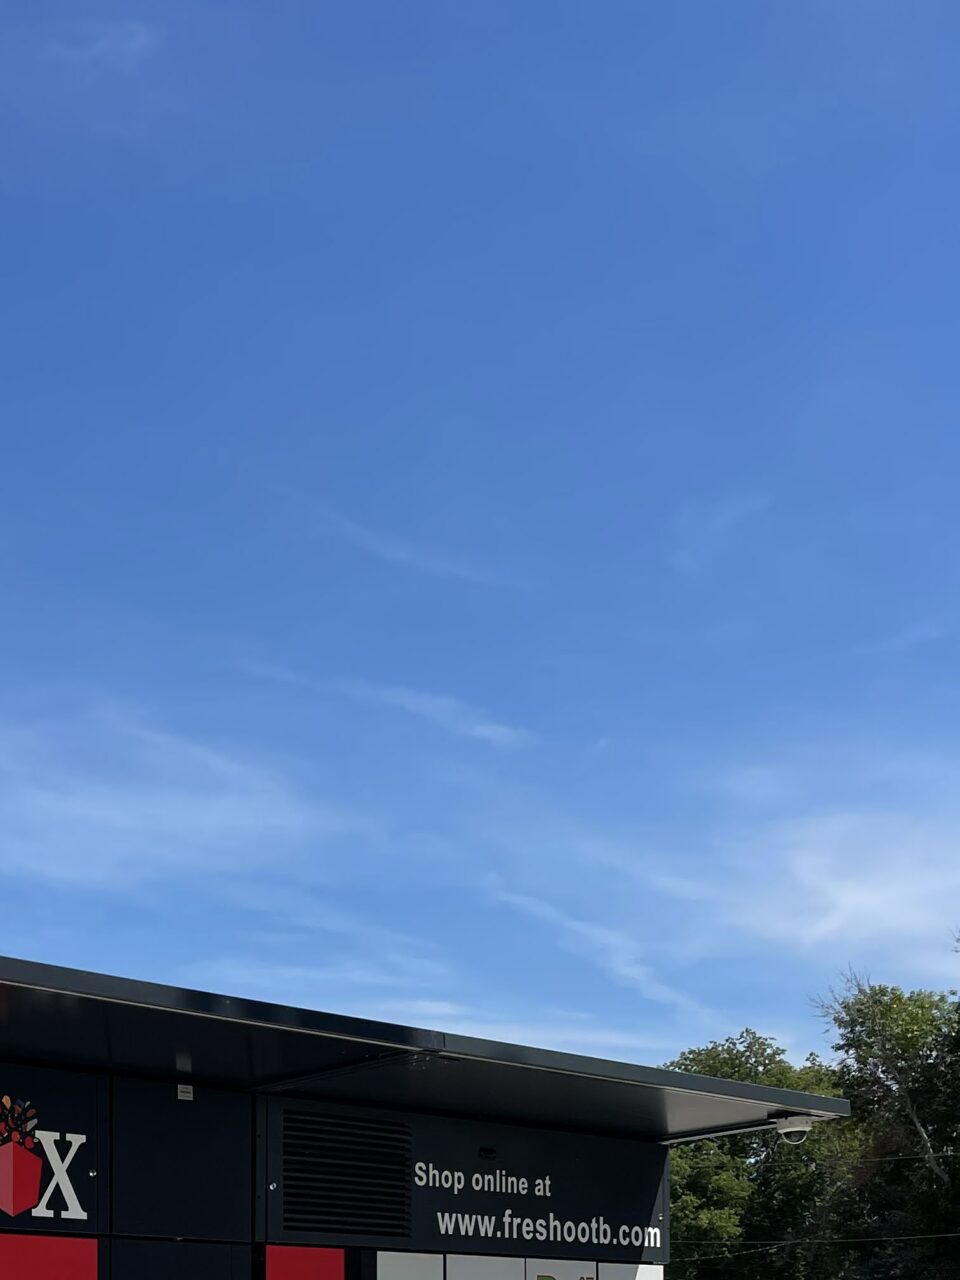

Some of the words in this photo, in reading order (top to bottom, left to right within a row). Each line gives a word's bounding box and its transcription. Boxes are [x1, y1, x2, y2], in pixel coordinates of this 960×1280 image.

[414, 1161, 465, 1195] Shop
[471, 1169, 529, 1195] online
[534, 1174, 552, 1197] at
[437, 1209, 661, 1248] www.freshootb.com
